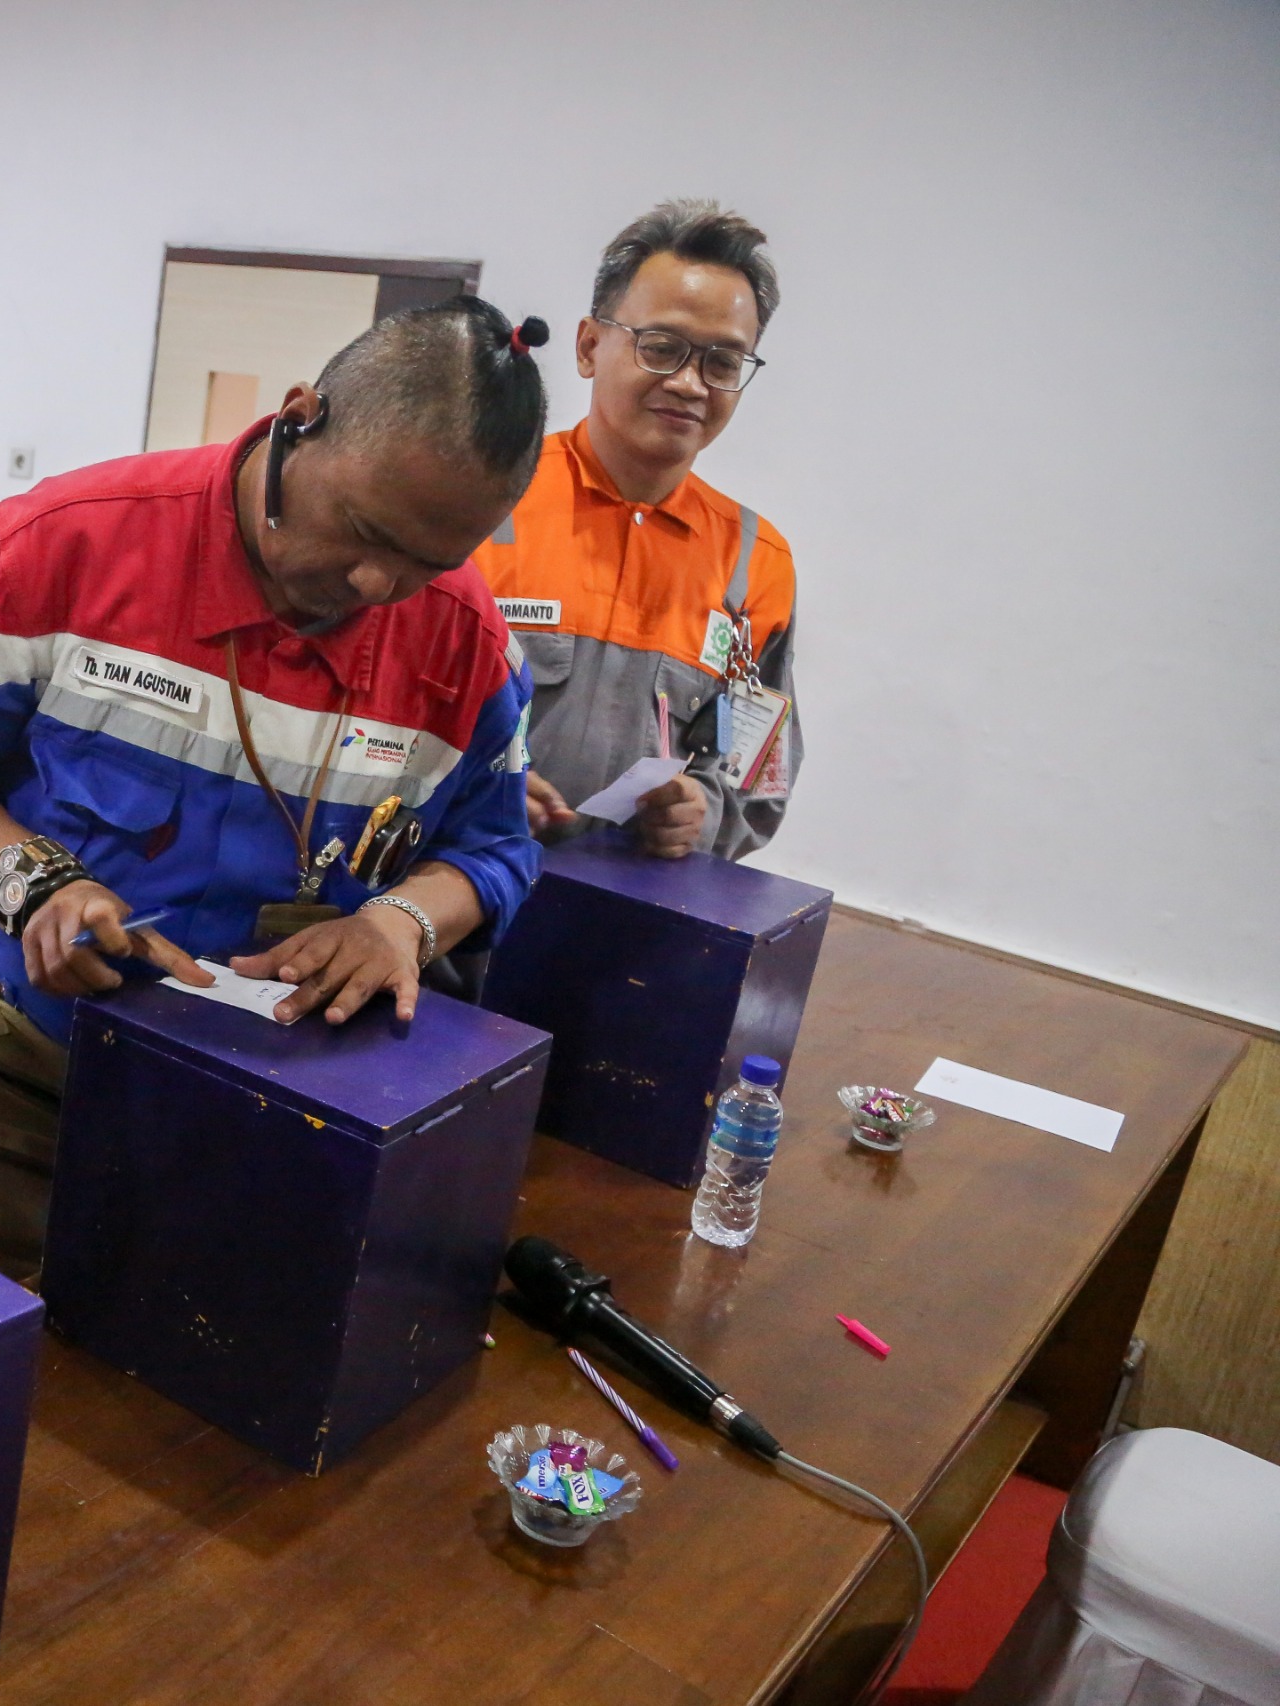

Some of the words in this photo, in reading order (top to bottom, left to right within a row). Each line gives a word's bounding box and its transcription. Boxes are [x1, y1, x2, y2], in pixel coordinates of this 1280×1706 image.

[84, 656, 98, 676] Tb.
[104, 662, 131, 684] TIAN
[133, 671, 191, 704] AGUSTIAN
[368, 738, 404, 751] PERTAMINA
[571, 1475, 590, 1504] FOX
